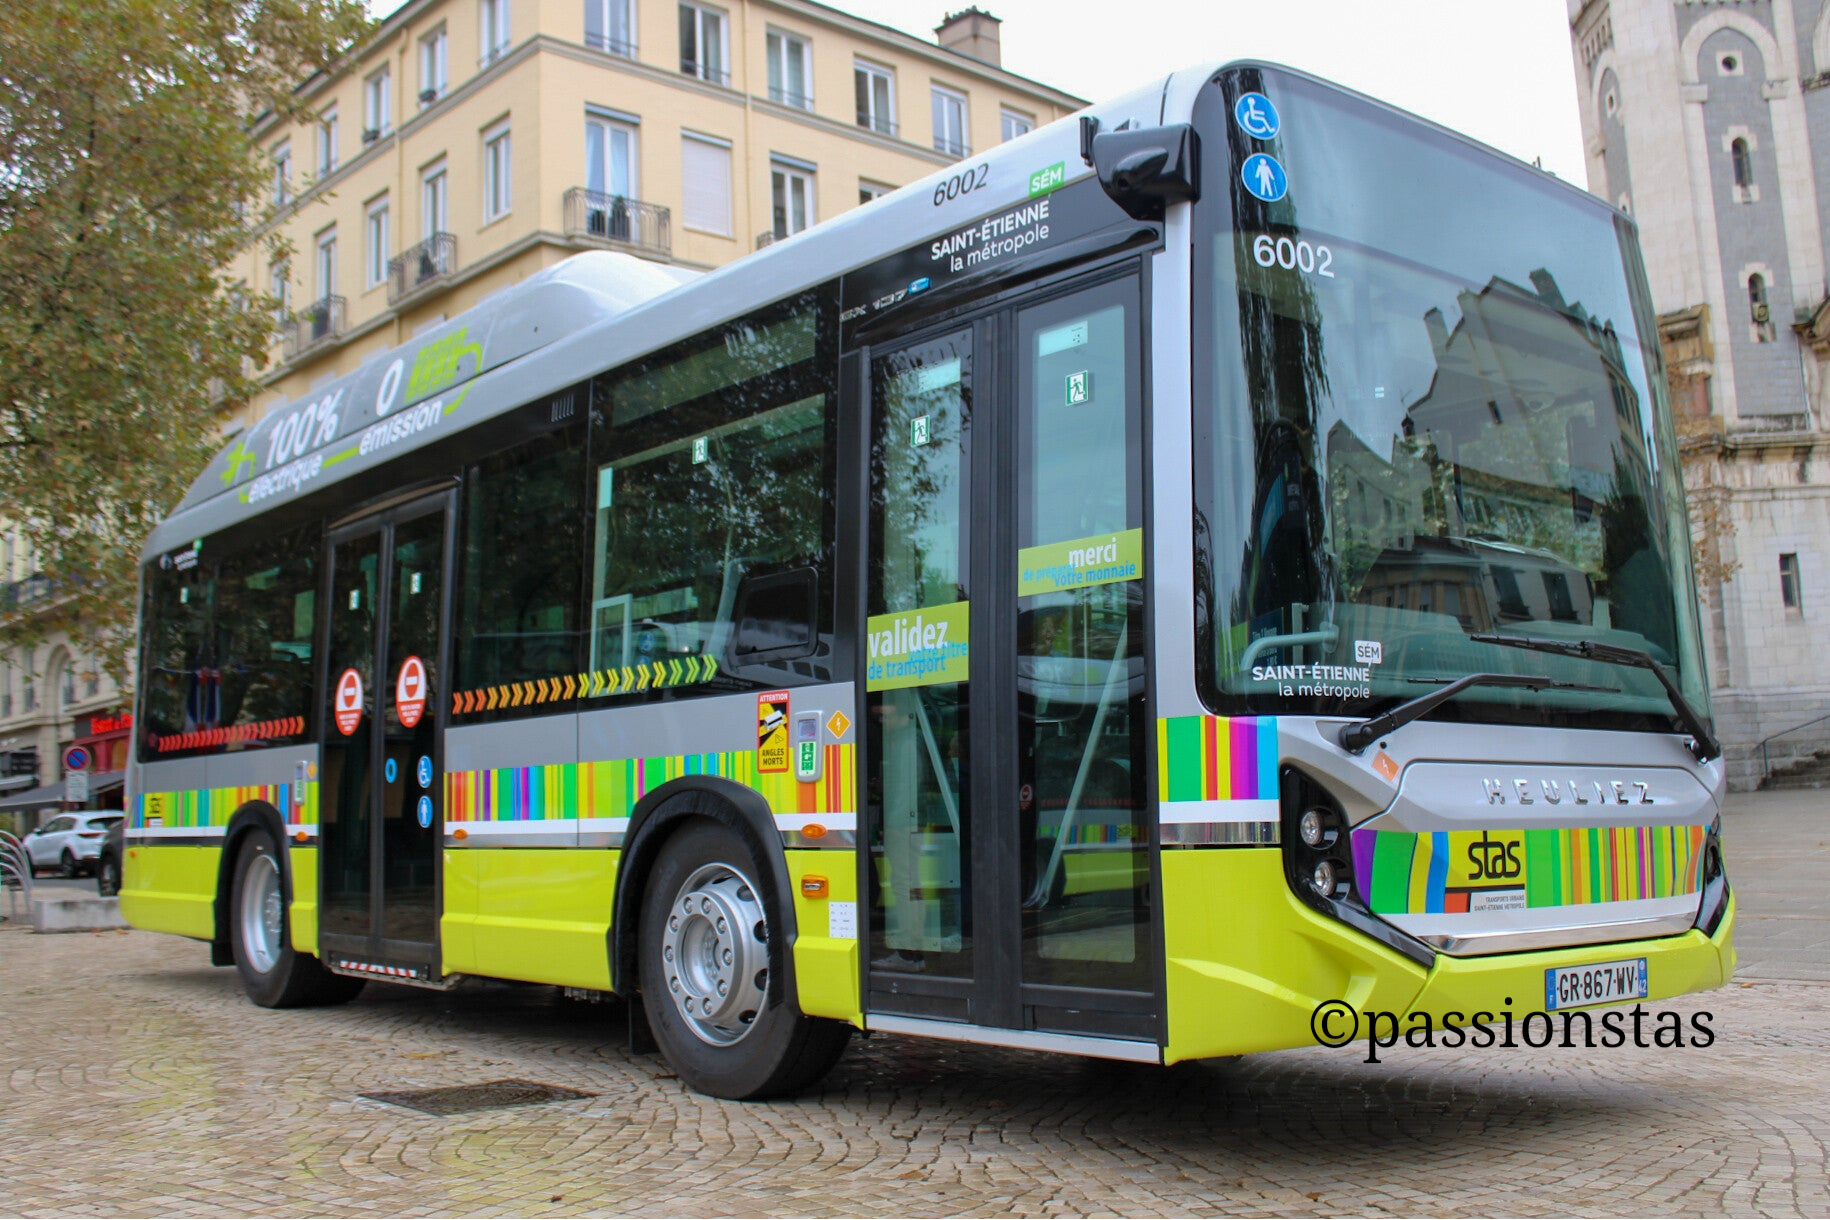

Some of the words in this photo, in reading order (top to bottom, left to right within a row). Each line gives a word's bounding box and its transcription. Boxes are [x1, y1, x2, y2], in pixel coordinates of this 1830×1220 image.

[933, 162, 989, 207] 6002
[1031, 166, 1063, 192] SÉM
[931, 199, 1050, 260] SAINT-ÉTIENNE
[950, 255, 964, 273] la
[966, 223, 1050, 266] métropole
[1253, 234, 1335, 279] 6002
[265, 388, 345, 470] 100%
[1068, 537, 1117, 568] merci
[1023, 567, 1034, 581] de
[1055, 568, 1083, 587] votre
[1086, 560, 1136, 581] monnaie
[868, 615, 948, 658] validez
[1357, 643, 1380, 659] SÉM
[868, 659, 883, 680] de
[886, 655, 946, 680] transport
[1252, 661, 1370, 682] SAINT-ÉTIENNE
[760, 693, 788, 702] ATTENTION
[1279, 682, 1294, 697] la
[1298, 682, 1370, 701] métropole
[762, 748, 784, 757] ANGLES
[763, 758, 783, 766] MORTS
[1482, 778, 1654, 805] HEULIEZ
[1468, 830, 1521, 880] stas
